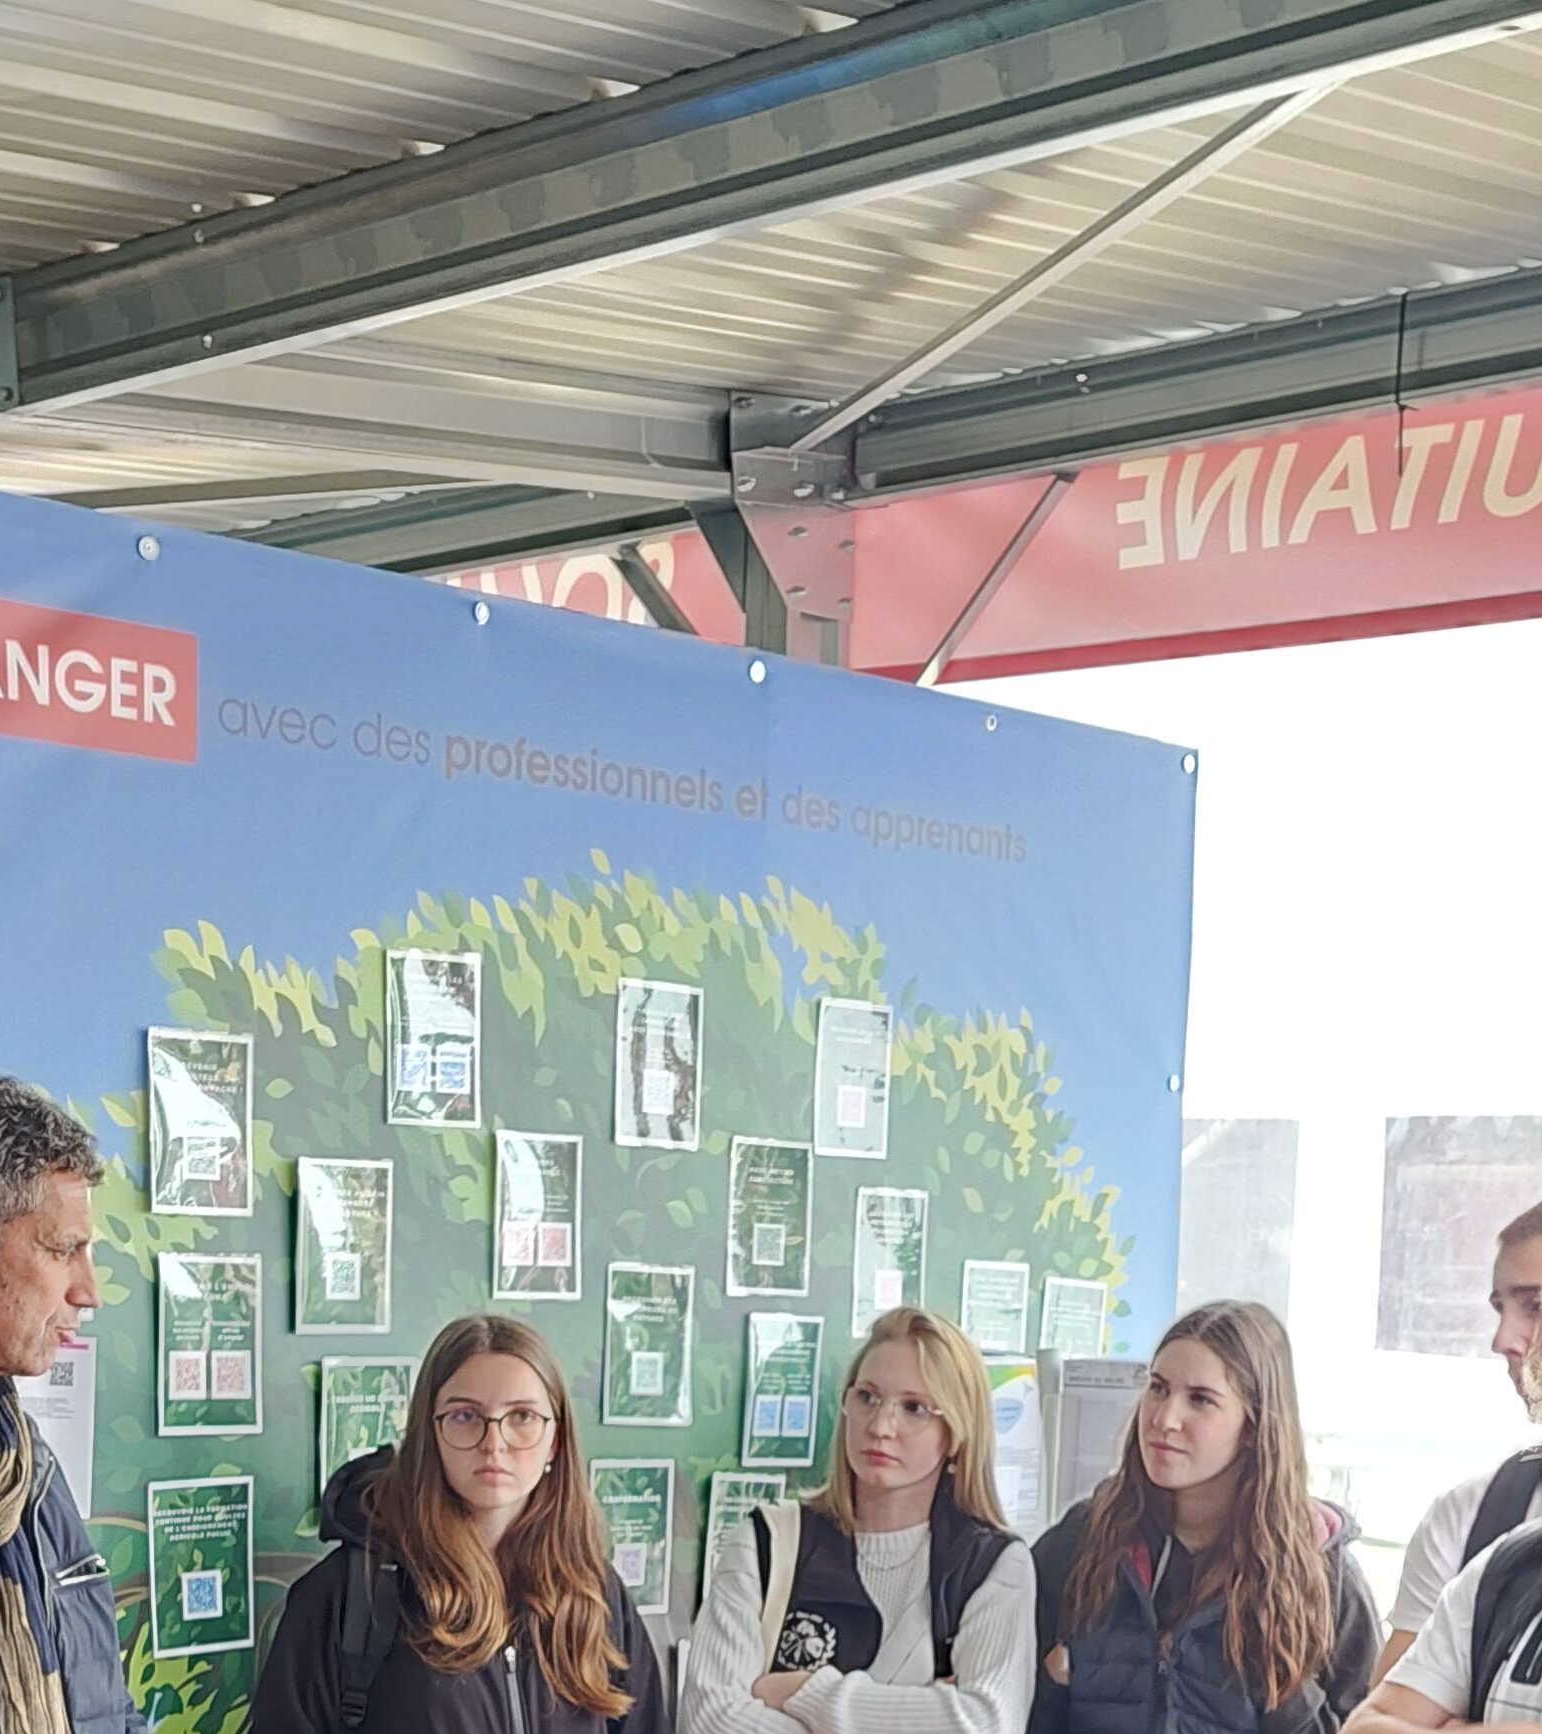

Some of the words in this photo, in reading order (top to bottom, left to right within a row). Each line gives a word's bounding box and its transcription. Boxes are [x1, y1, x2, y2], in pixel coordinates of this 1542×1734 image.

[217, 694, 338, 752] avec
[352, 709, 432, 764] des
[444, 728, 723, 813] professionnels
[735, 776, 770, 820] et
[780, 784, 848, 832] des
[852, 801, 1029, 864] apprenants
